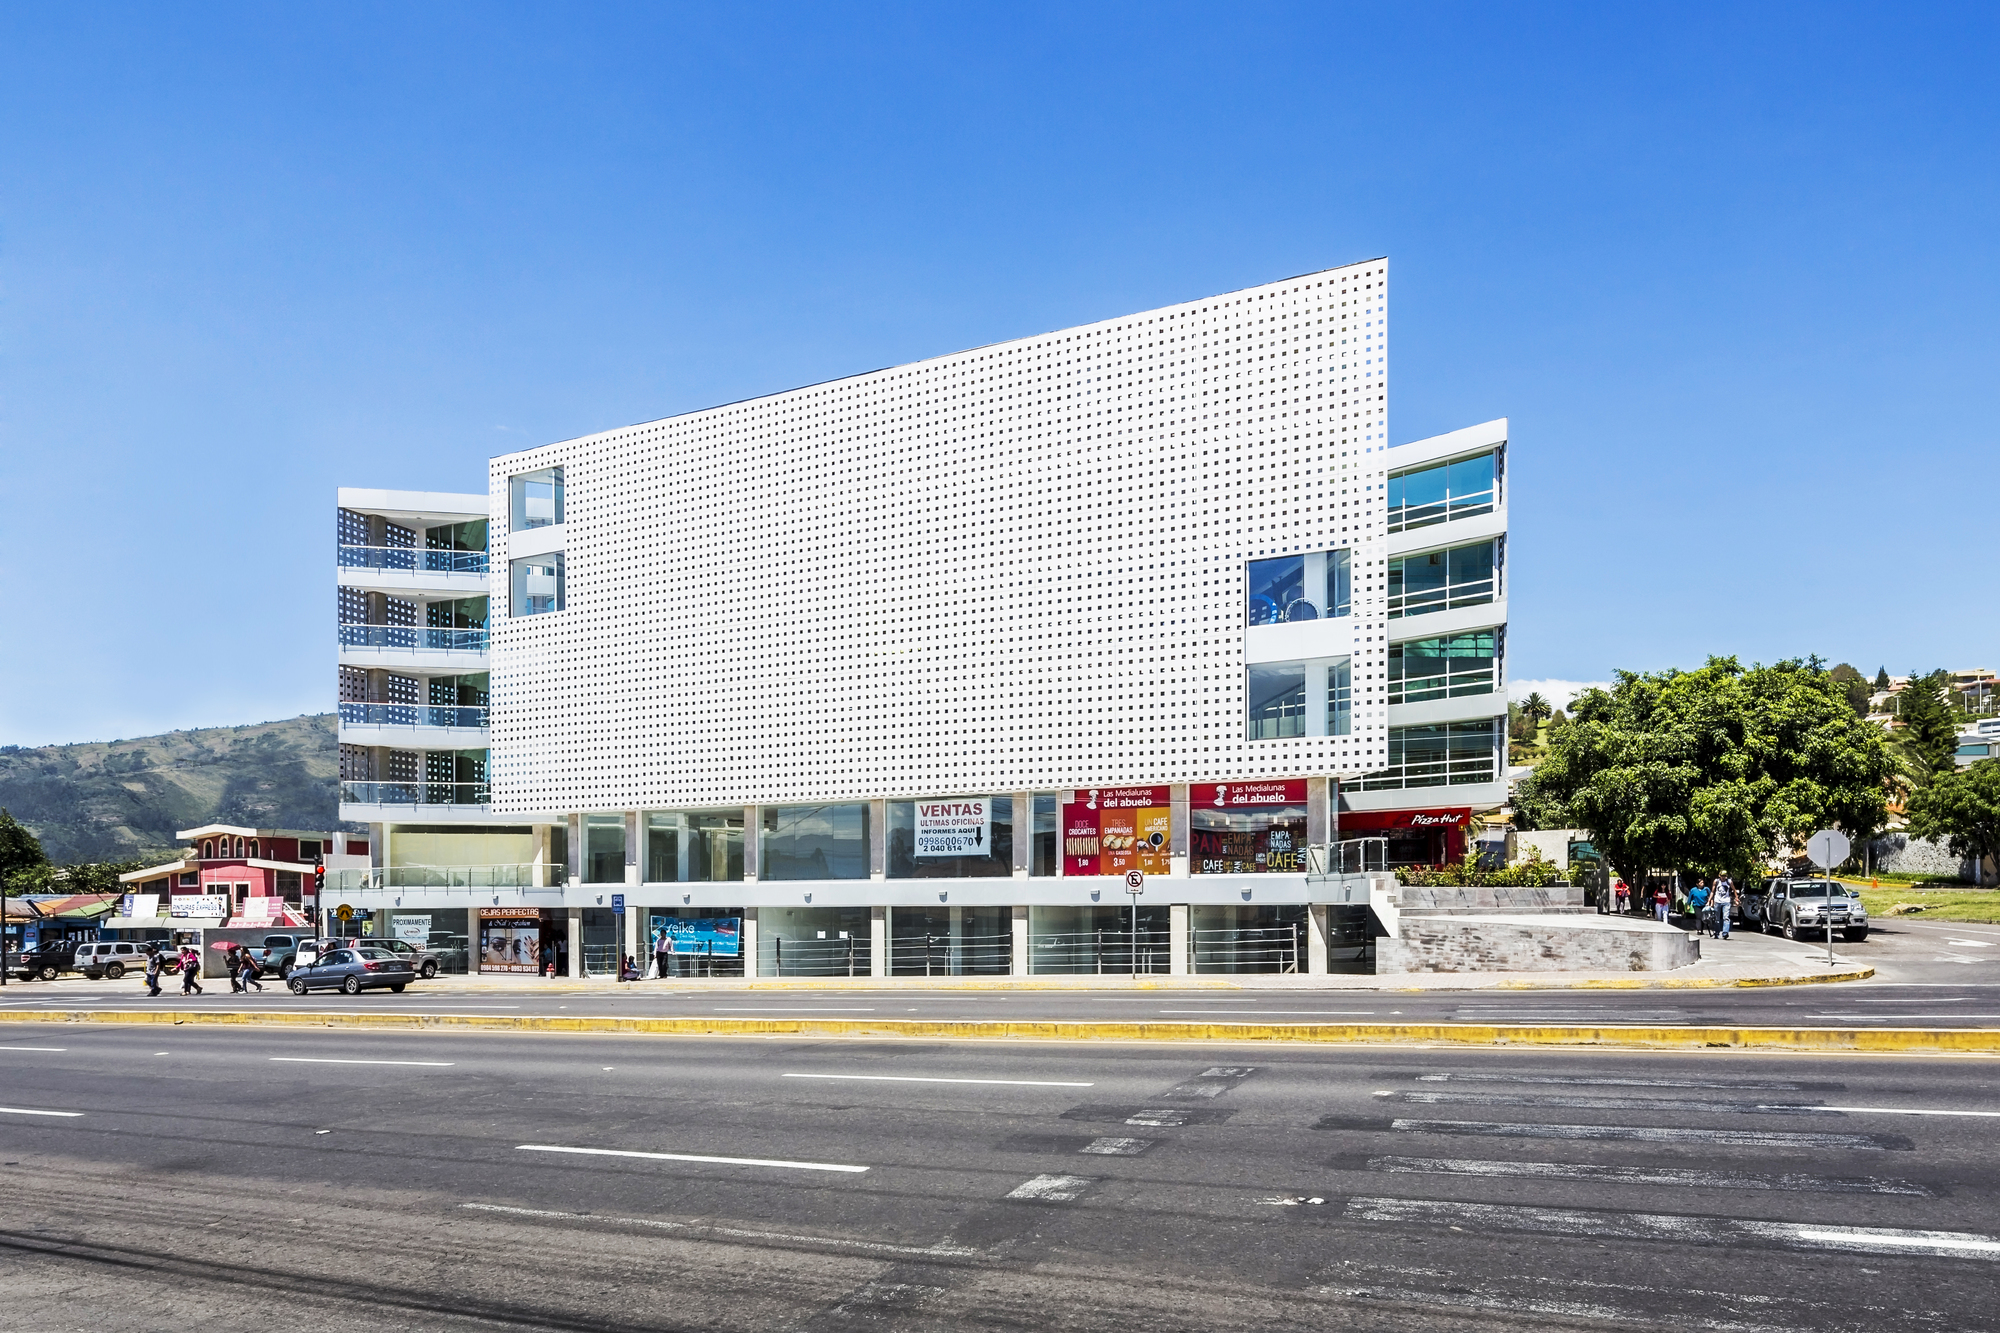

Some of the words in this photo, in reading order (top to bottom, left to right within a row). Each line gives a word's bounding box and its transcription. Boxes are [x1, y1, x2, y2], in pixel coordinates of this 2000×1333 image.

[1115, 789, 1152, 797] Medialunas
[1245, 784, 1285, 792] Medialunas
[1103, 798, 1117, 807] del
[1120, 797, 1152, 807] abuelo
[1232, 794, 1247, 804] del
[1250, 792, 1285, 803] abuelo
[920, 803, 983, 817] VENTAS
[921, 819, 949, 827] ULTIMAS
[952, 818, 984, 826] OFICINAS
[1075, 820, 1089, 828] DOCE
[1154, 817, 1168, 826] CAFÉ
[1411, 815, 1439, 825] Pizza
[1441, 814, 1462, 824] Hut
[918, 837, 973, 846] 0998600670
[1191, 833, 1222, 853] PAN
[1271, 840, 1291, 848] NADAS
[1228, 845, 1254, 855] NADAS
[1297, 847, 1306, 863] PAN
[1203, 858, 1223, 870] CAFÉ
[1267, 850, 1297, 868] CAFÉ
[480, 908, 500, 916] CEJAS
[501, 908, 539, 916] PERFECTAS
